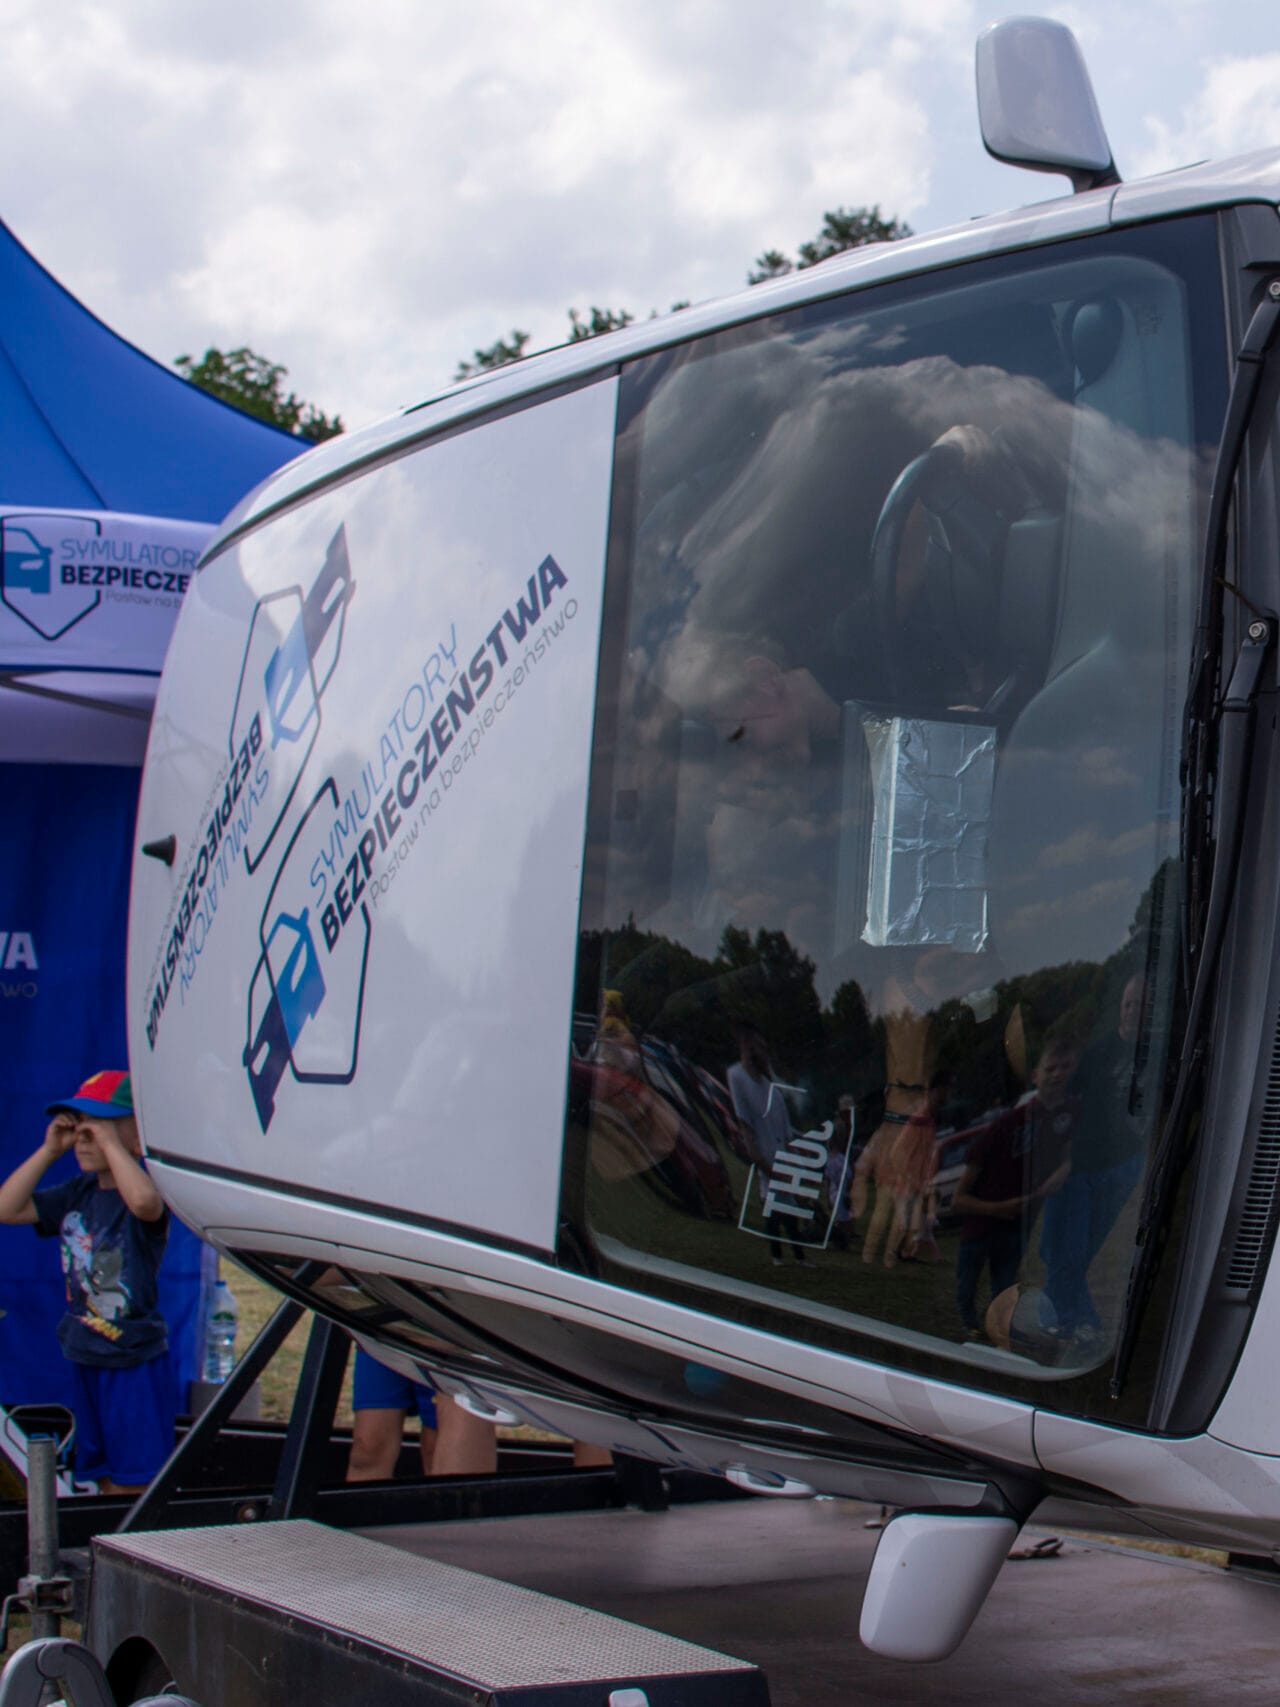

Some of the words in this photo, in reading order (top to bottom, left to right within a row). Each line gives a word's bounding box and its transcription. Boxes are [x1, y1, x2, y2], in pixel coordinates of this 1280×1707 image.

[60, 537, 200, 569] SYMULATOR
[310, 623, 458, 907] SYMULATORY
[320, 554, 569, 953] BEZPIECZEŃSTWA
[369, 820, 419, 908] Postaw
[420, 788, 441, 826] na
